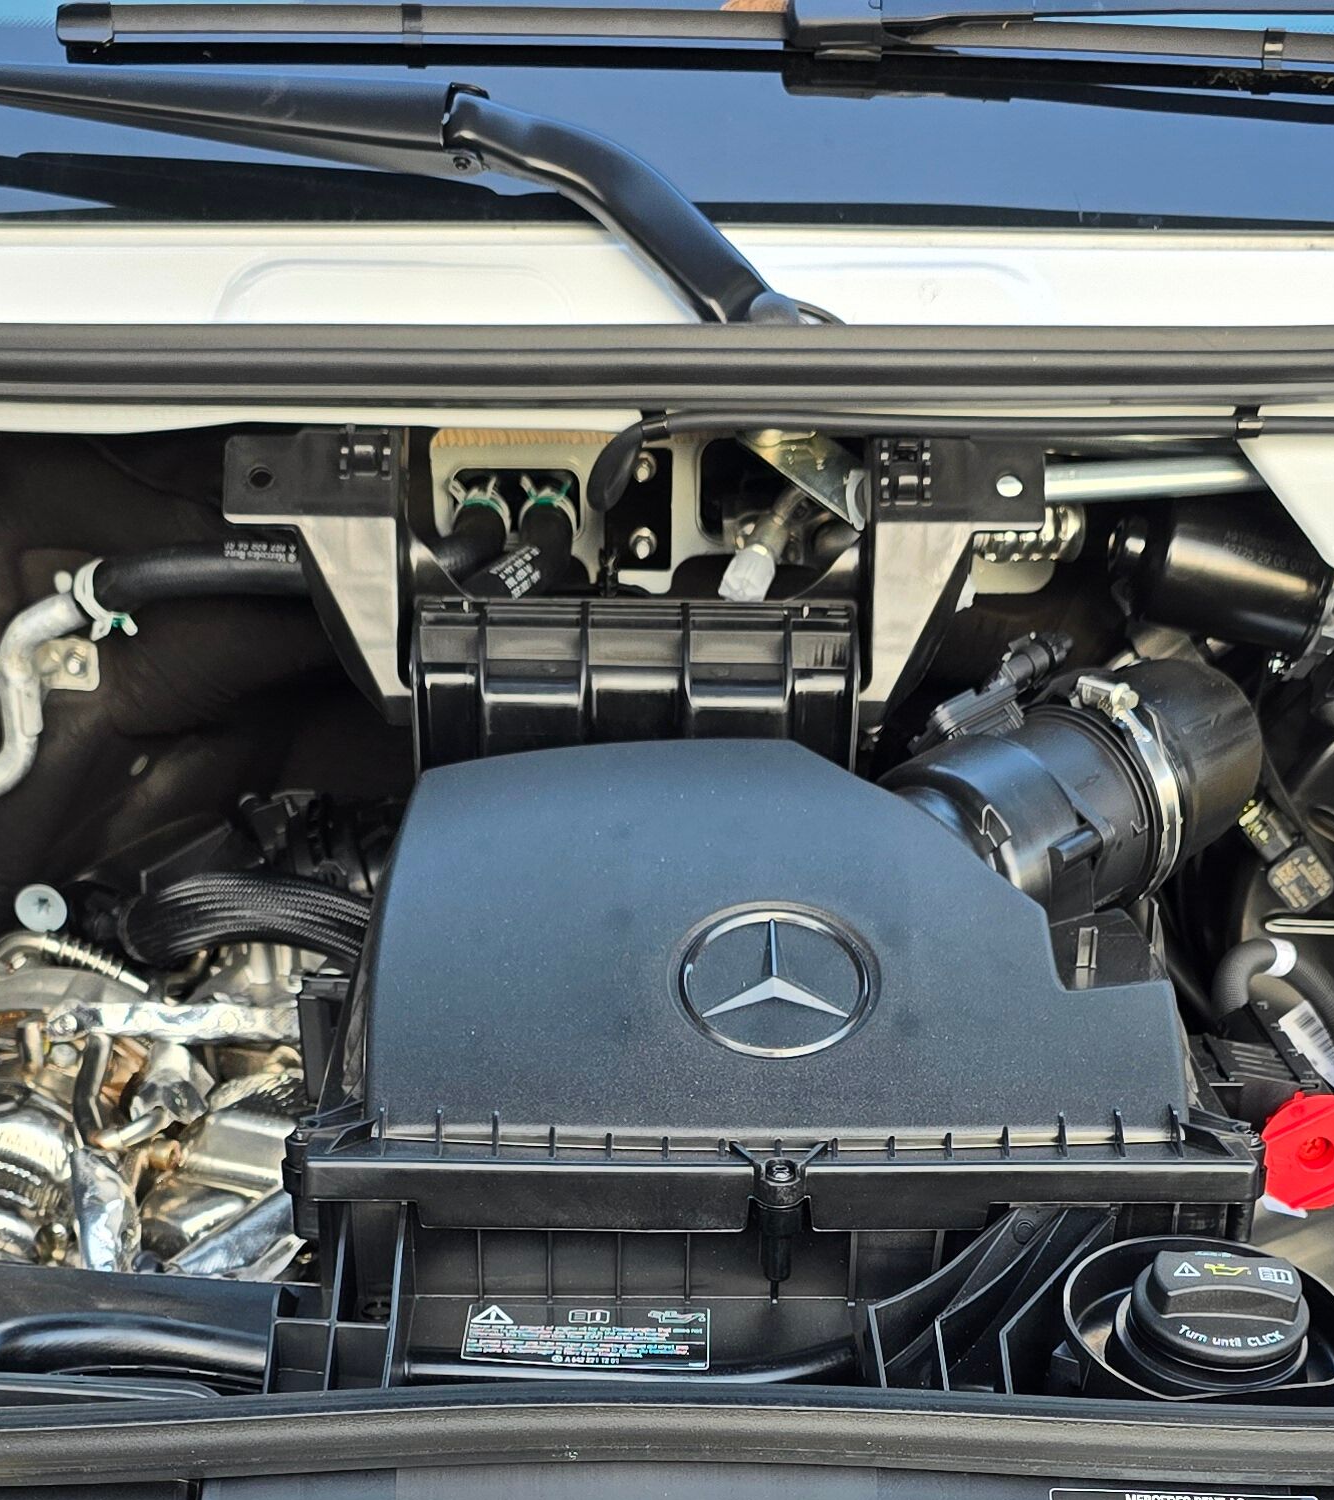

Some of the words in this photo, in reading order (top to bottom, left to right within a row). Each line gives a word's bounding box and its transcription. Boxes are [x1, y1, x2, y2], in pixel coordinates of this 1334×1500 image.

[1178, 1324, 1208, 1344] Turn
[1212, 1336, 1242, 1348] until
[1247, 1330, 1286, 1347] CLICK
